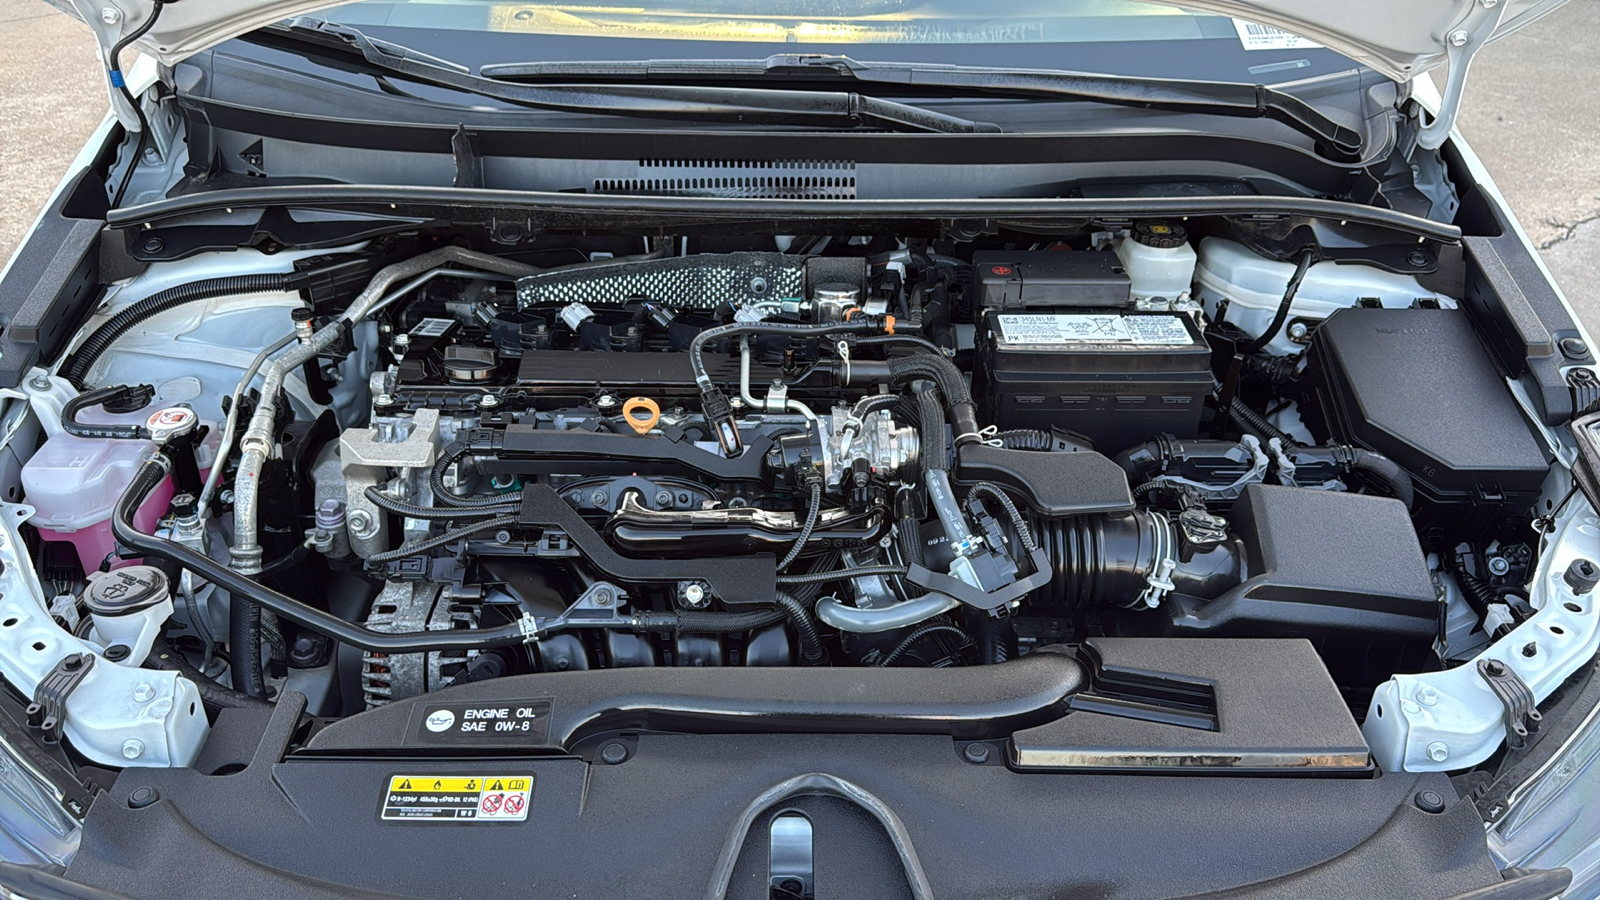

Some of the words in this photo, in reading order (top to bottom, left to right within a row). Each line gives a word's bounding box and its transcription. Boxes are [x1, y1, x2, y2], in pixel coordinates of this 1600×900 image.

[1421, 464, 1436, 478] K6
[463, 709, 509, 719] ENGINE
[516, 708, 536, 718] OIL
[461, 721, 487, 732] SAE
[495, 720, 530, 732] 0W-8
